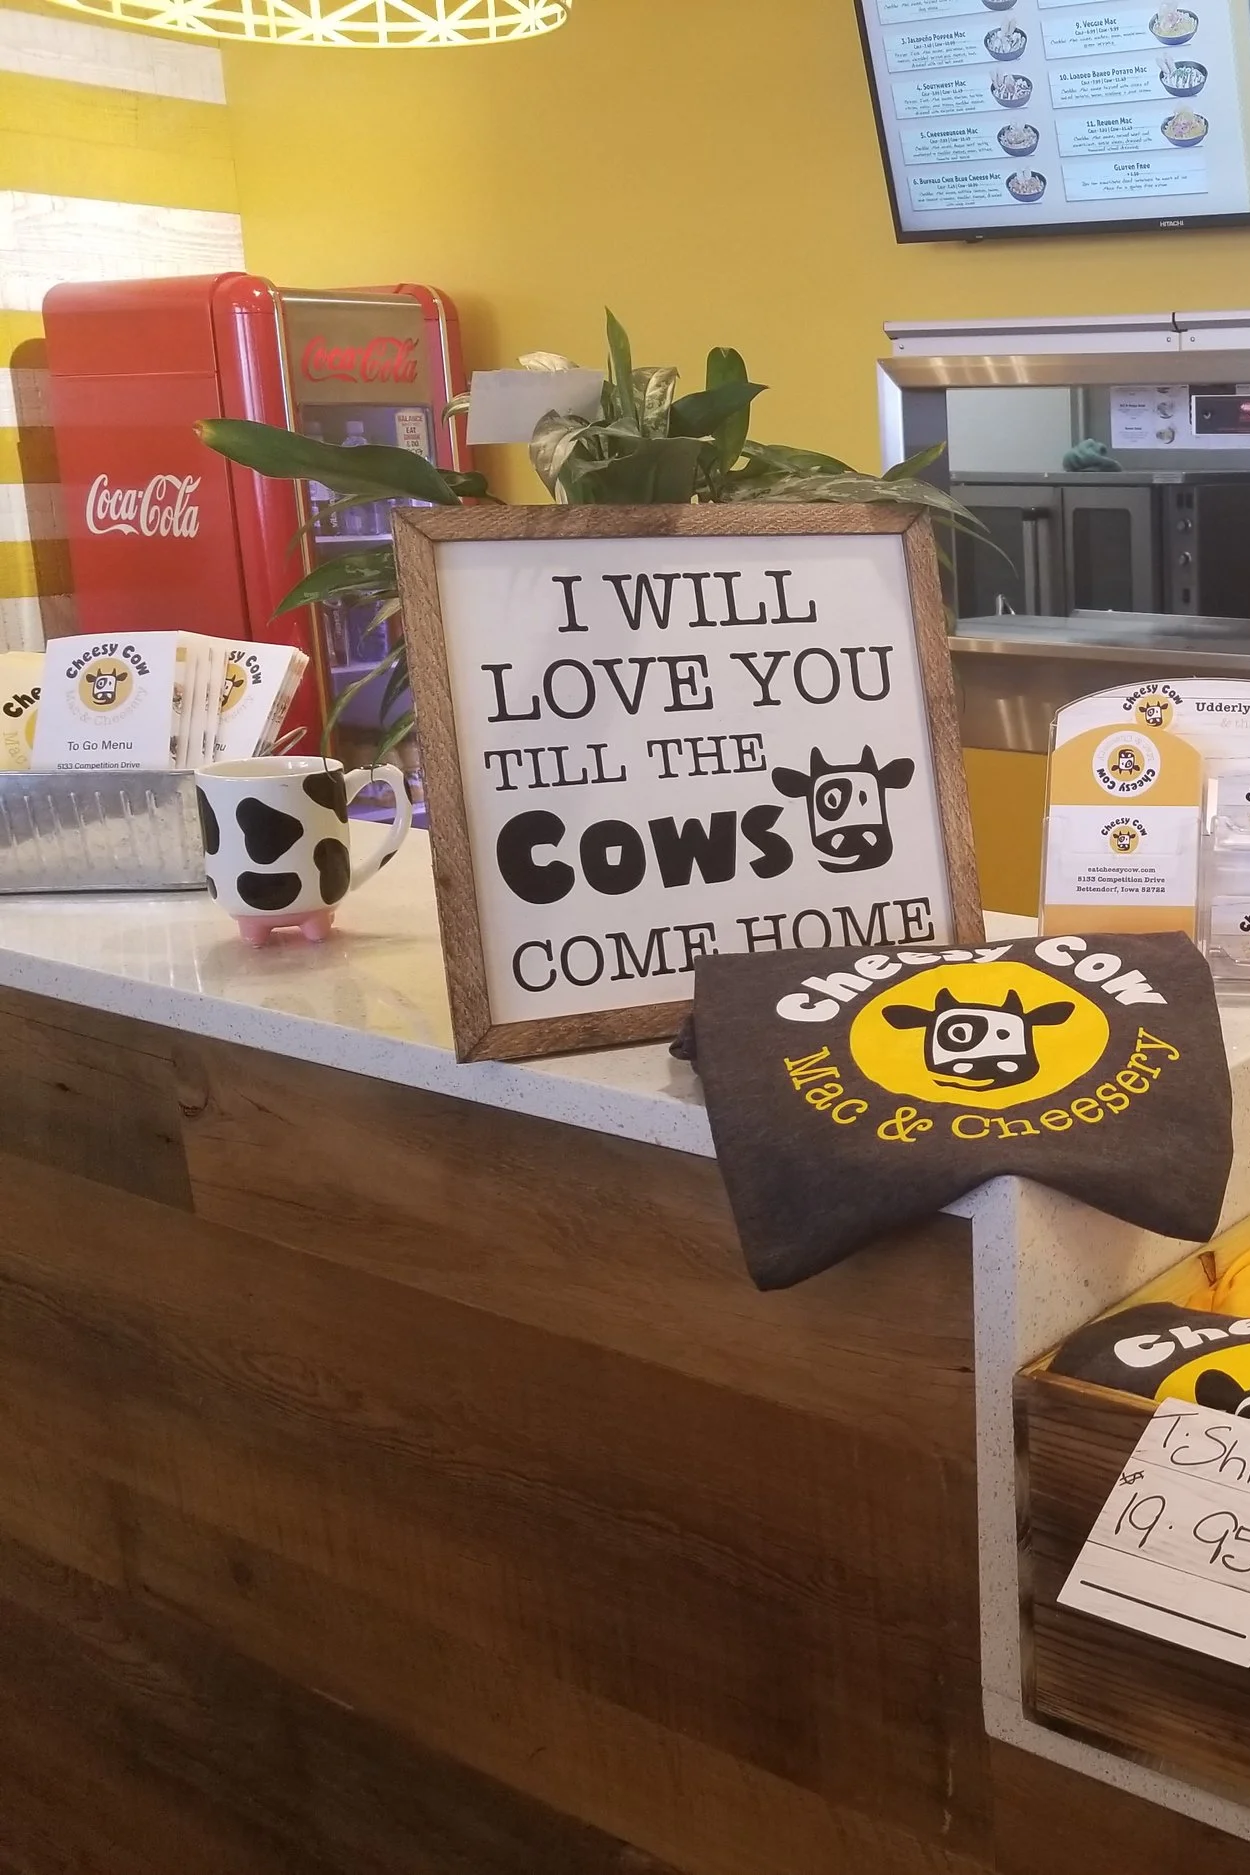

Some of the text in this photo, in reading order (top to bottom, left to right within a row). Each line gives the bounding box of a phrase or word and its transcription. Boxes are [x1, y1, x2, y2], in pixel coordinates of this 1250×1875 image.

[303, 336, 420, 384] Coca-Cola
[86, 473, 202, 538] Coca-Cola
[551, 569, 818, 633] I WILL
[65, 643, 150, 679] Cheesy Cow
[245, 655, 262, 685] Cow
[481, 645, 894, 723] LOVE YOU
[1123, 684, 1183, 711] Cheesy Cow
[2, 687, 42, 718] Che
[1195, 702, 1250, 715] Udderly
[67, 740, 133, 751] To Go Menu
[484, 733, 767, 791] TILL THE
[74, 762, 119, 770] Competition
[1096, 768, 1156, 792] Cheesy Cow
[1101, 817, 1148, 836] Cheesy Cow
[1076, 886, 1119, 894] Bettendorf,
[512, 897, 935, 993] COME HOME
[1034, 936, 1168, 1007] Cow
[783, 1026, 1181, 1144] Mac & Cheesery
